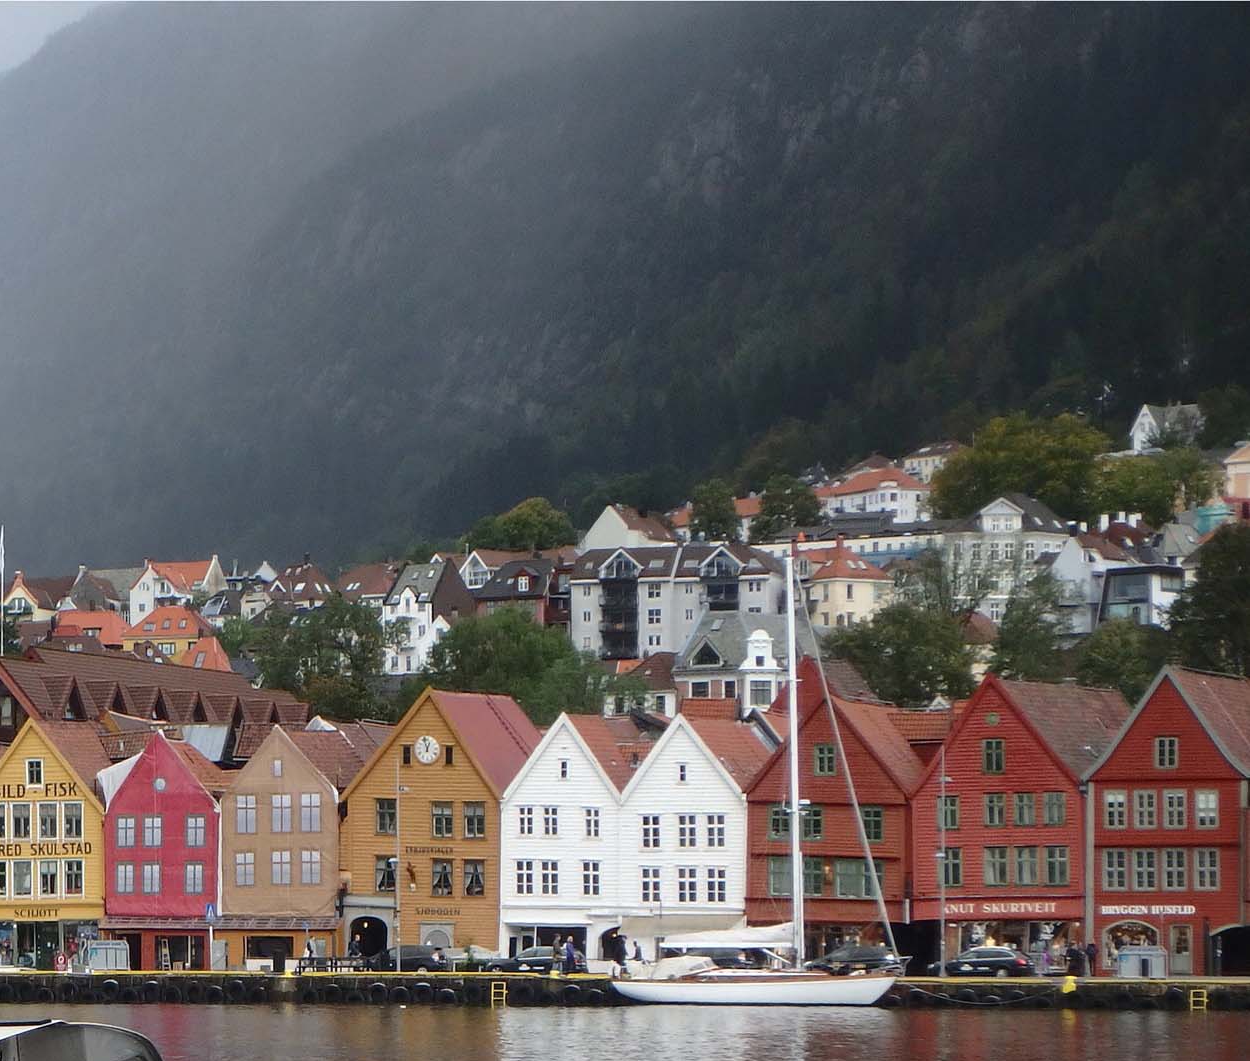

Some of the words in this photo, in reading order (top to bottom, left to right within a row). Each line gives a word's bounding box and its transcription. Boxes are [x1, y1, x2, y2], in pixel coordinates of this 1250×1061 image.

[45, 782, 78, 797] FISK
[30, 842, 92, 856] SKULSTAD
[982, 902, 1056, 913] SKURTVEIT
[1101, 905, 1148, 915] BRYGGEN
[1151, 905, 1196, 915] HUSFLID
